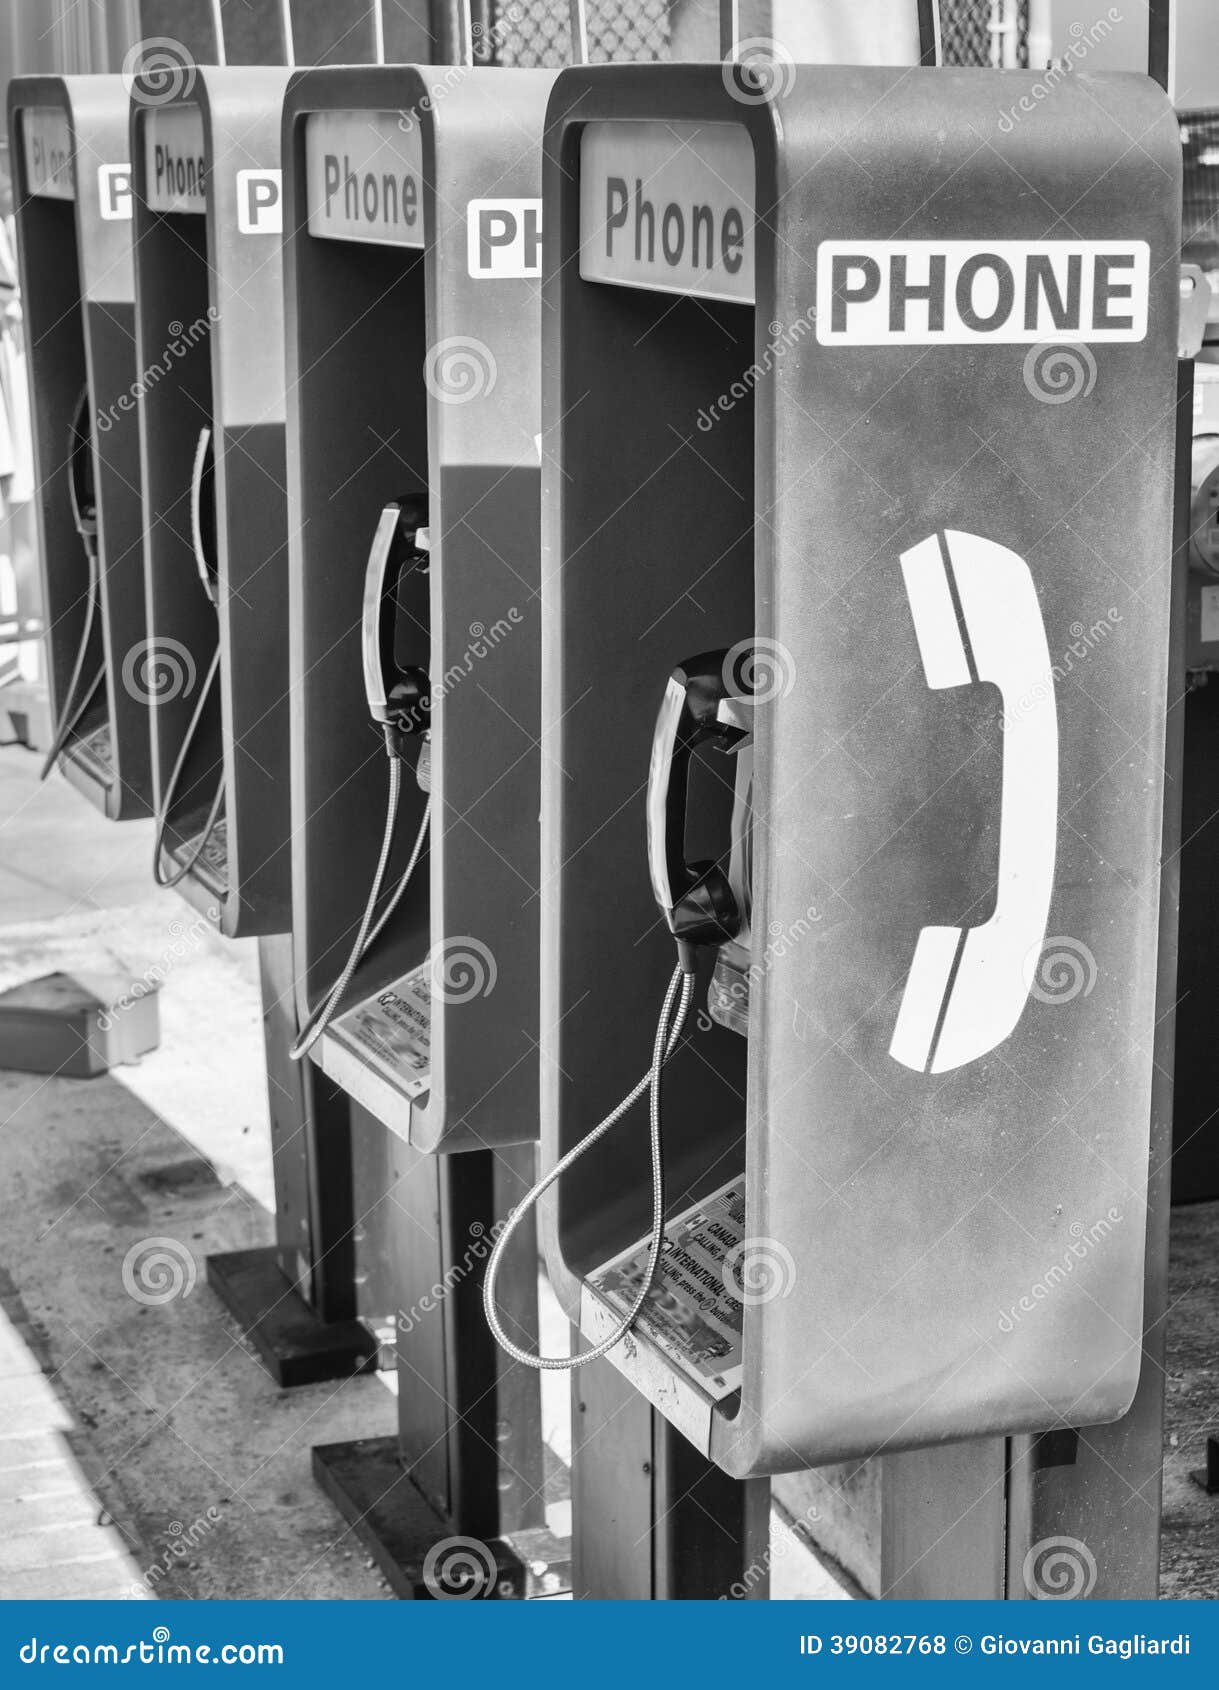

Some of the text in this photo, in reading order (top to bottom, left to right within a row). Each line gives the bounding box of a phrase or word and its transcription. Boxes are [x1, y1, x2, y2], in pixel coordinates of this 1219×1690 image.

[247, 178, 279, 226] P
[325, 154, 418, 226] Phone
[605, 176, 743, 274] Phone
[829, 252, 1136, 333] PHONE
[661, 1258, 683, 1286] ALLING,
[668, 1247, 726, 1297] INTERNATIONAL
